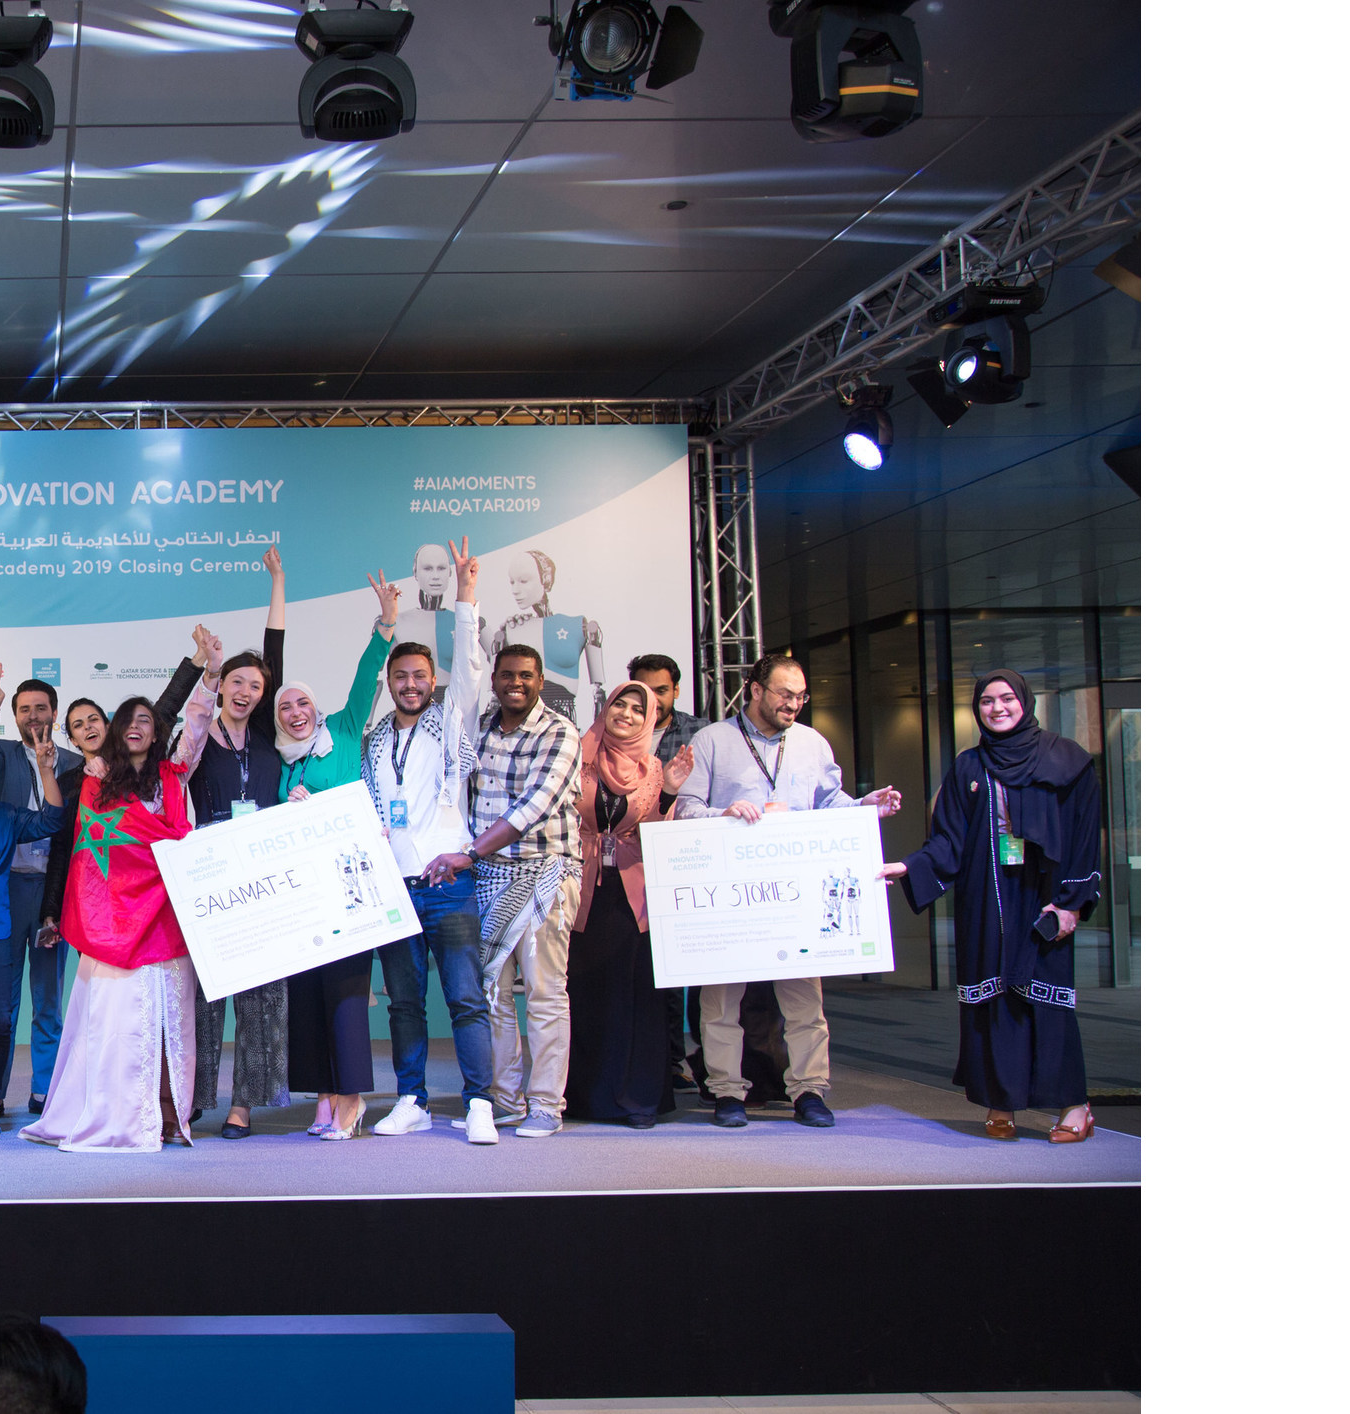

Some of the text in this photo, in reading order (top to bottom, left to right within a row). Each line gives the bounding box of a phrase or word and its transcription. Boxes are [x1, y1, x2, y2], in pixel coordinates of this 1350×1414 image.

[130, 479, 284, 504] ACADEMY
[413, 476, 537, 490] #AIAMOMENTS
[410, 498, 540, 516] #AIAQATAR2019
[61, 531, 150, 550] للأكاديمية
[154, 531, 223, 552] الختامي
[227, 530, 280, 547] الحفل
[72, 560, 112, 574] 2019
[119, 559, 184, 576] Closing
[190, 558, 266, 574] Ceremo
[248, 813, 355, 858] FIRST PLACE
[735, 837, 860, 860] SECOND PLACE
[194, 869, 302, 918] SALAMAT-E
[674, 881, 800, 910] FLY STORIES
